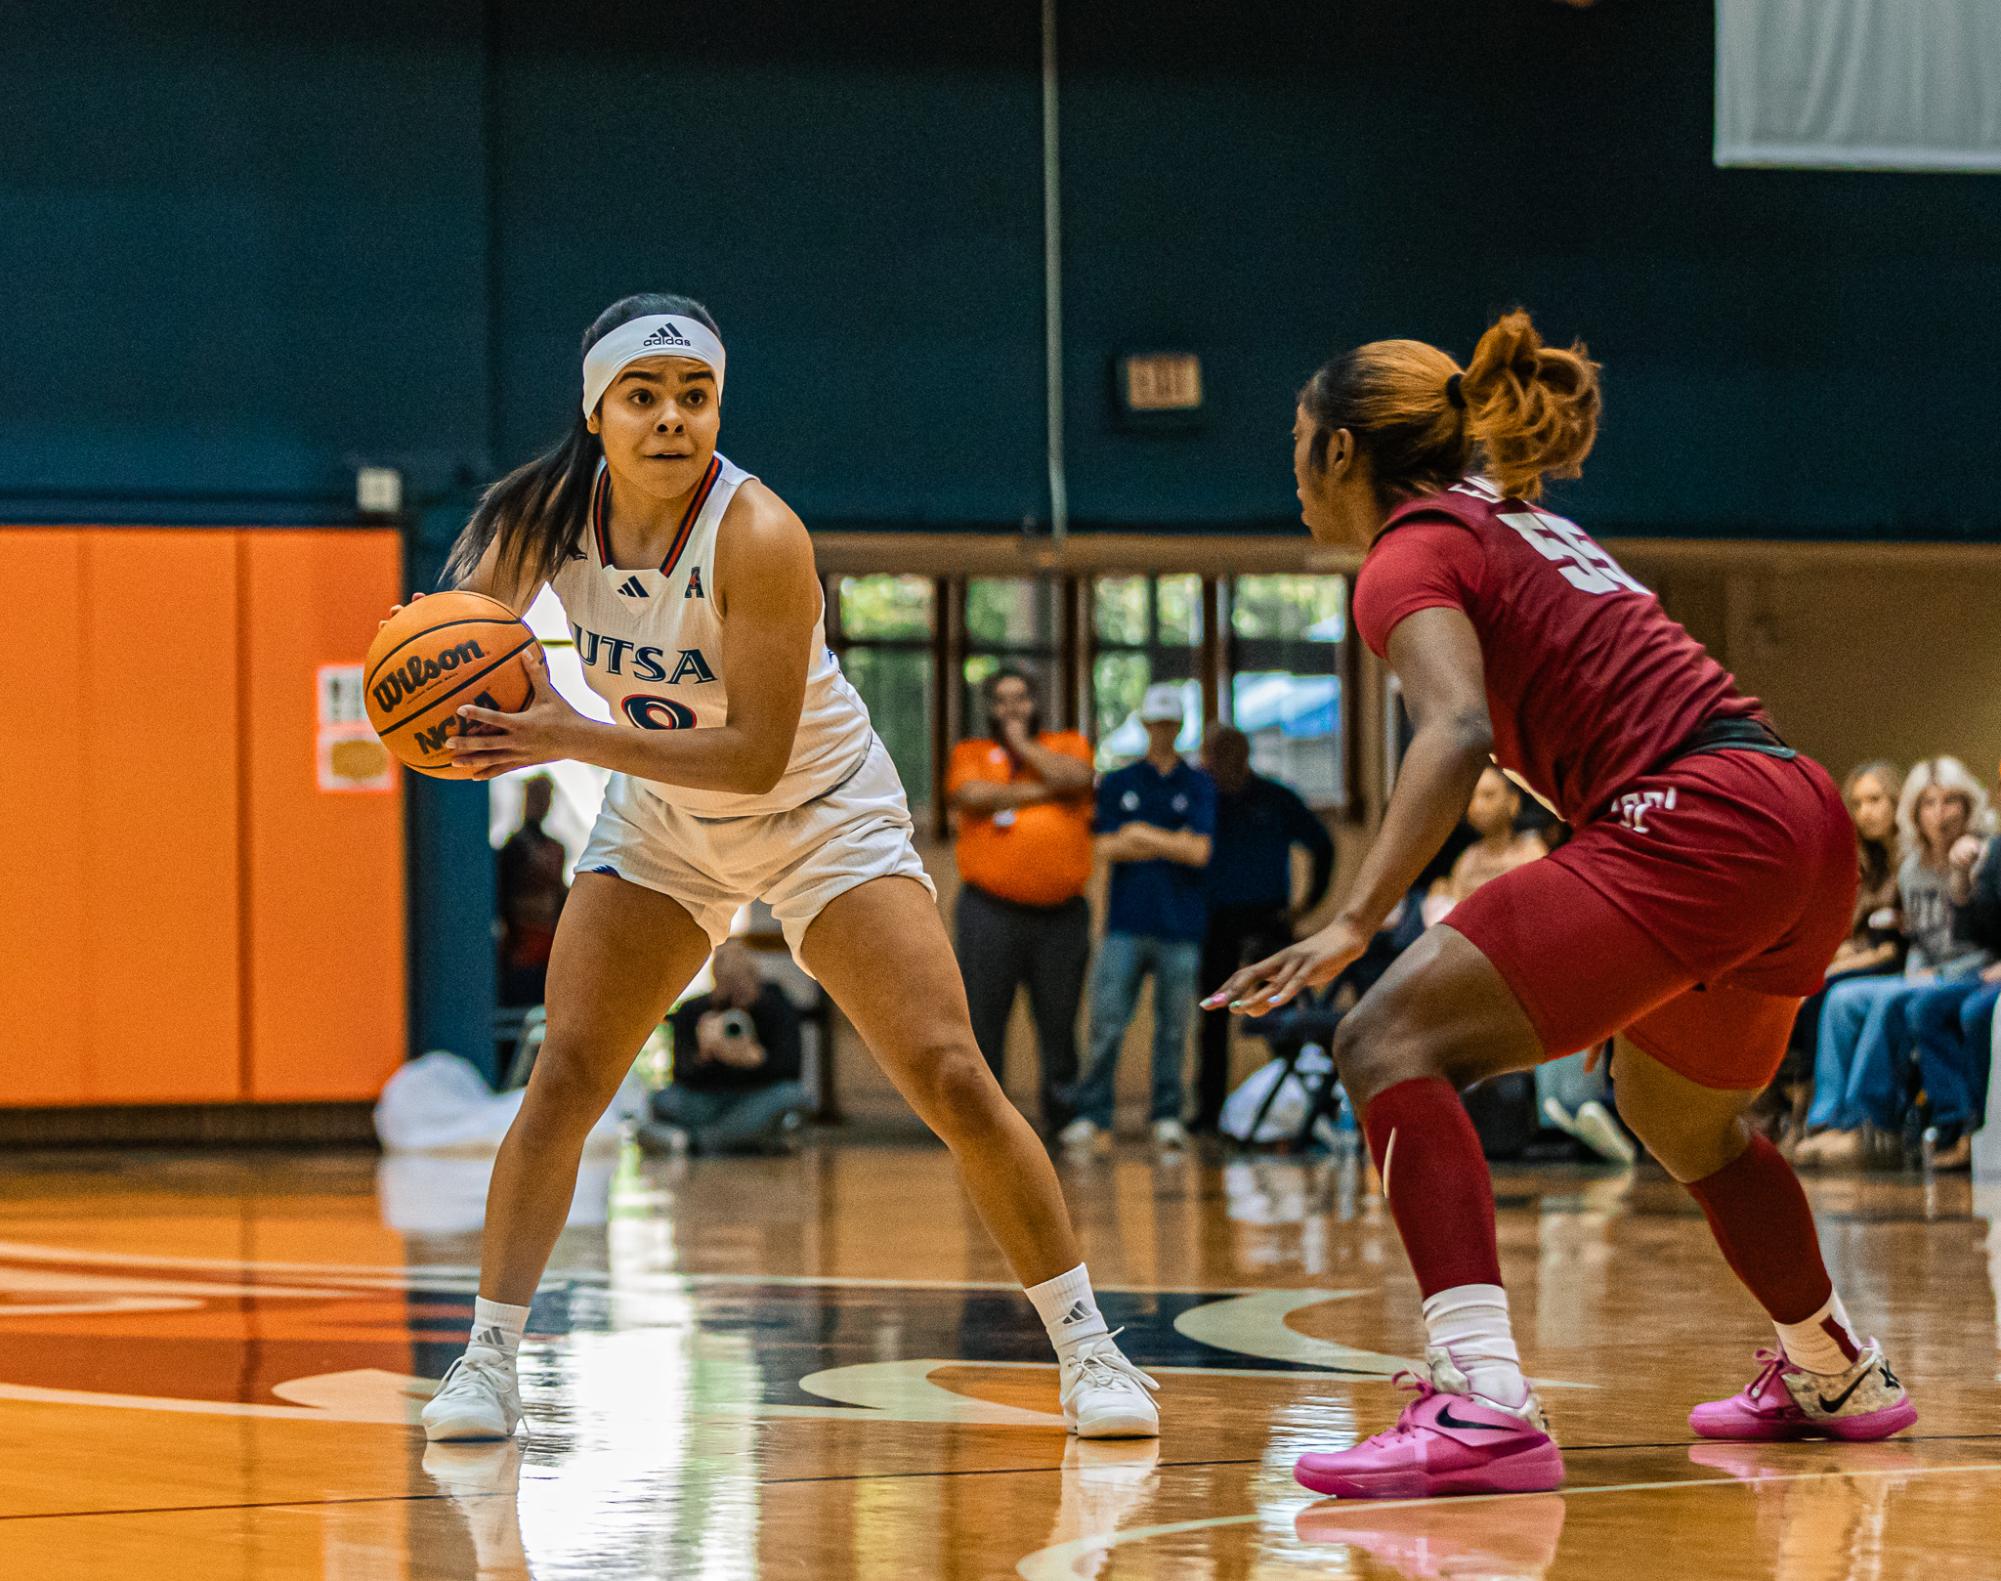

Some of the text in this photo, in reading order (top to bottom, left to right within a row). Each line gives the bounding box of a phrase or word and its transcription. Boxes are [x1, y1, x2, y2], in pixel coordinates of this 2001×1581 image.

[643, 336, 691, 347] adidas
[1496, 515, 1653, 596] 55
[372, 639, 485, 713] Wilson
[572, 622, 718, 685] UTSA
